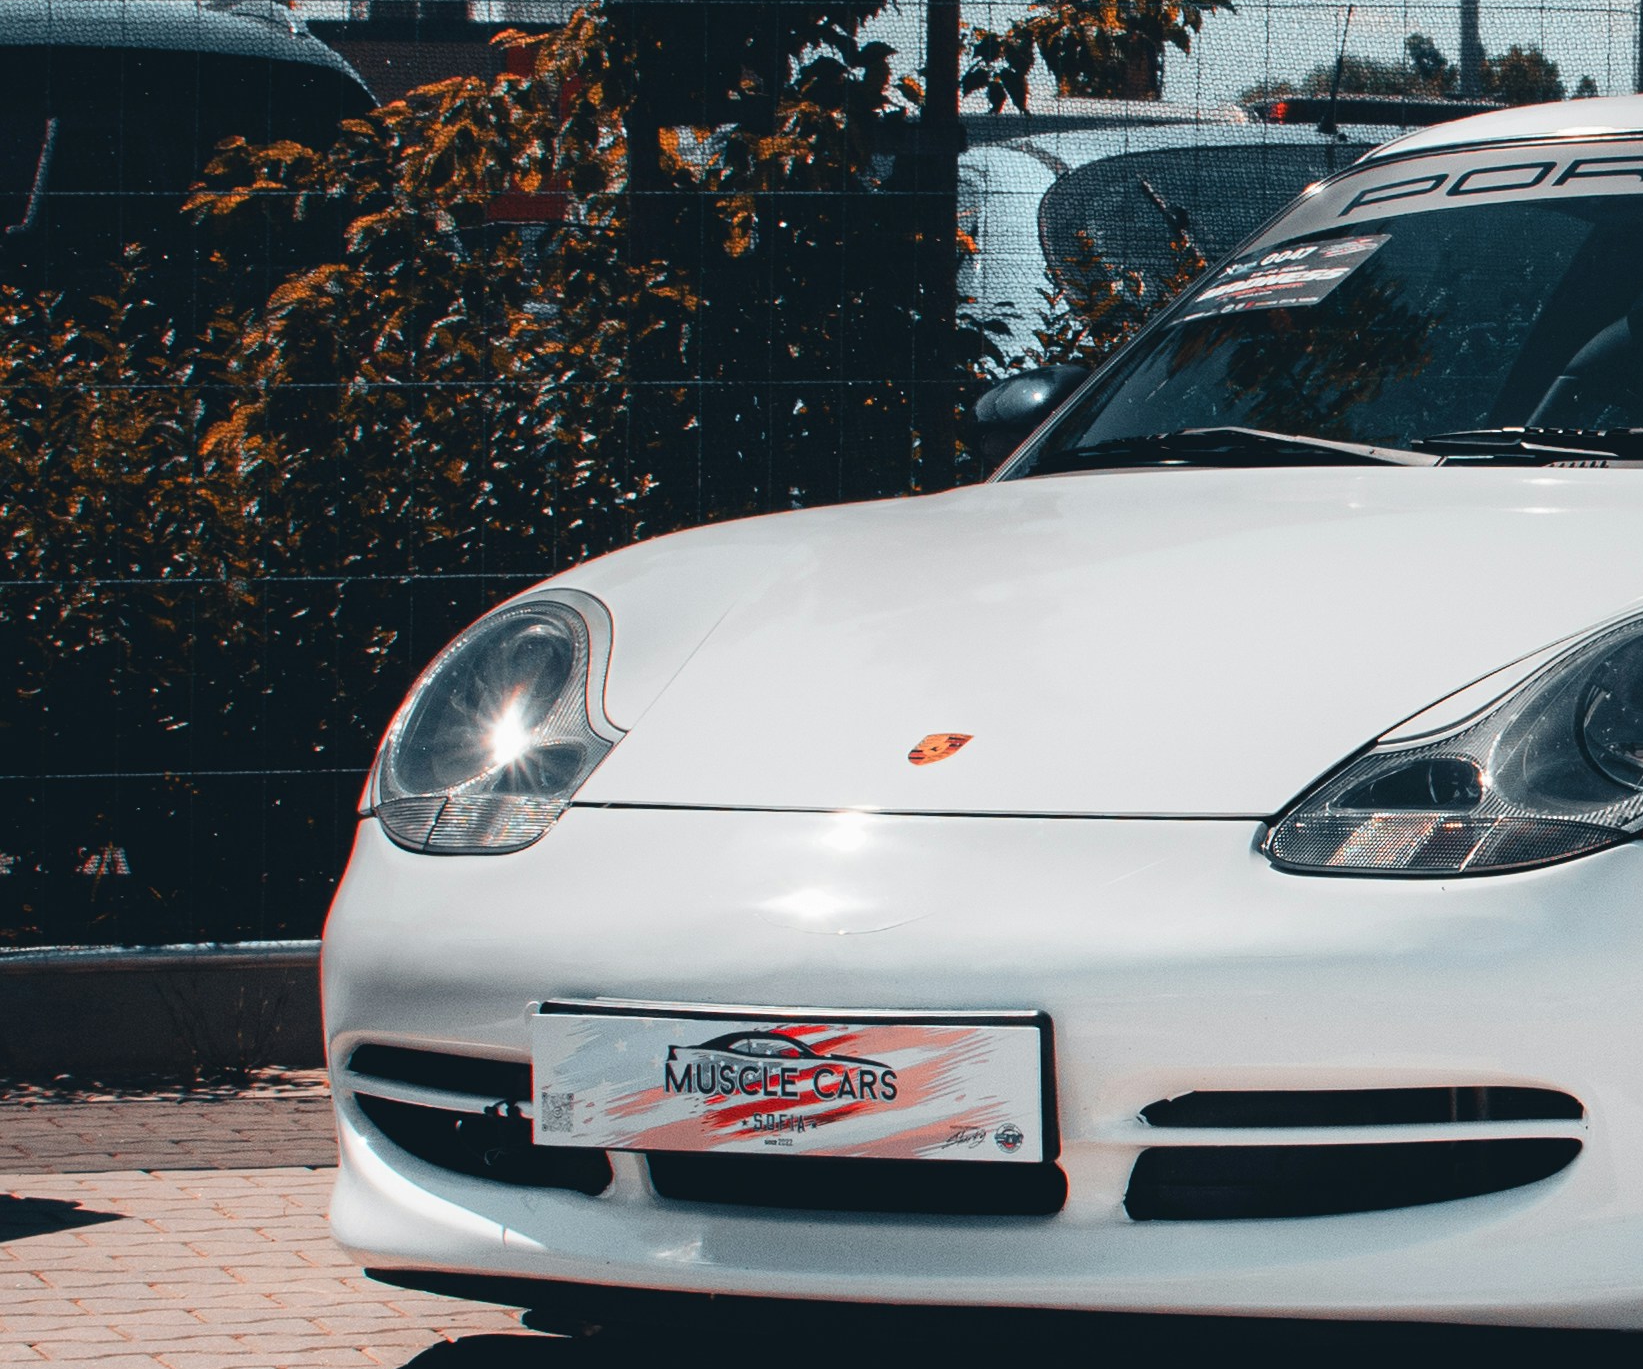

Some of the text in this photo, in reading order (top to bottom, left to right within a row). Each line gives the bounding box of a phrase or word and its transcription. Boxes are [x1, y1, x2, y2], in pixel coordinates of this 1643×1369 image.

[1260, 245, 1319, 266] 0047
[664, 1062, 899, 1101] MUSCLE CARS
[753, 1112, 806, 1133] SOFIA
